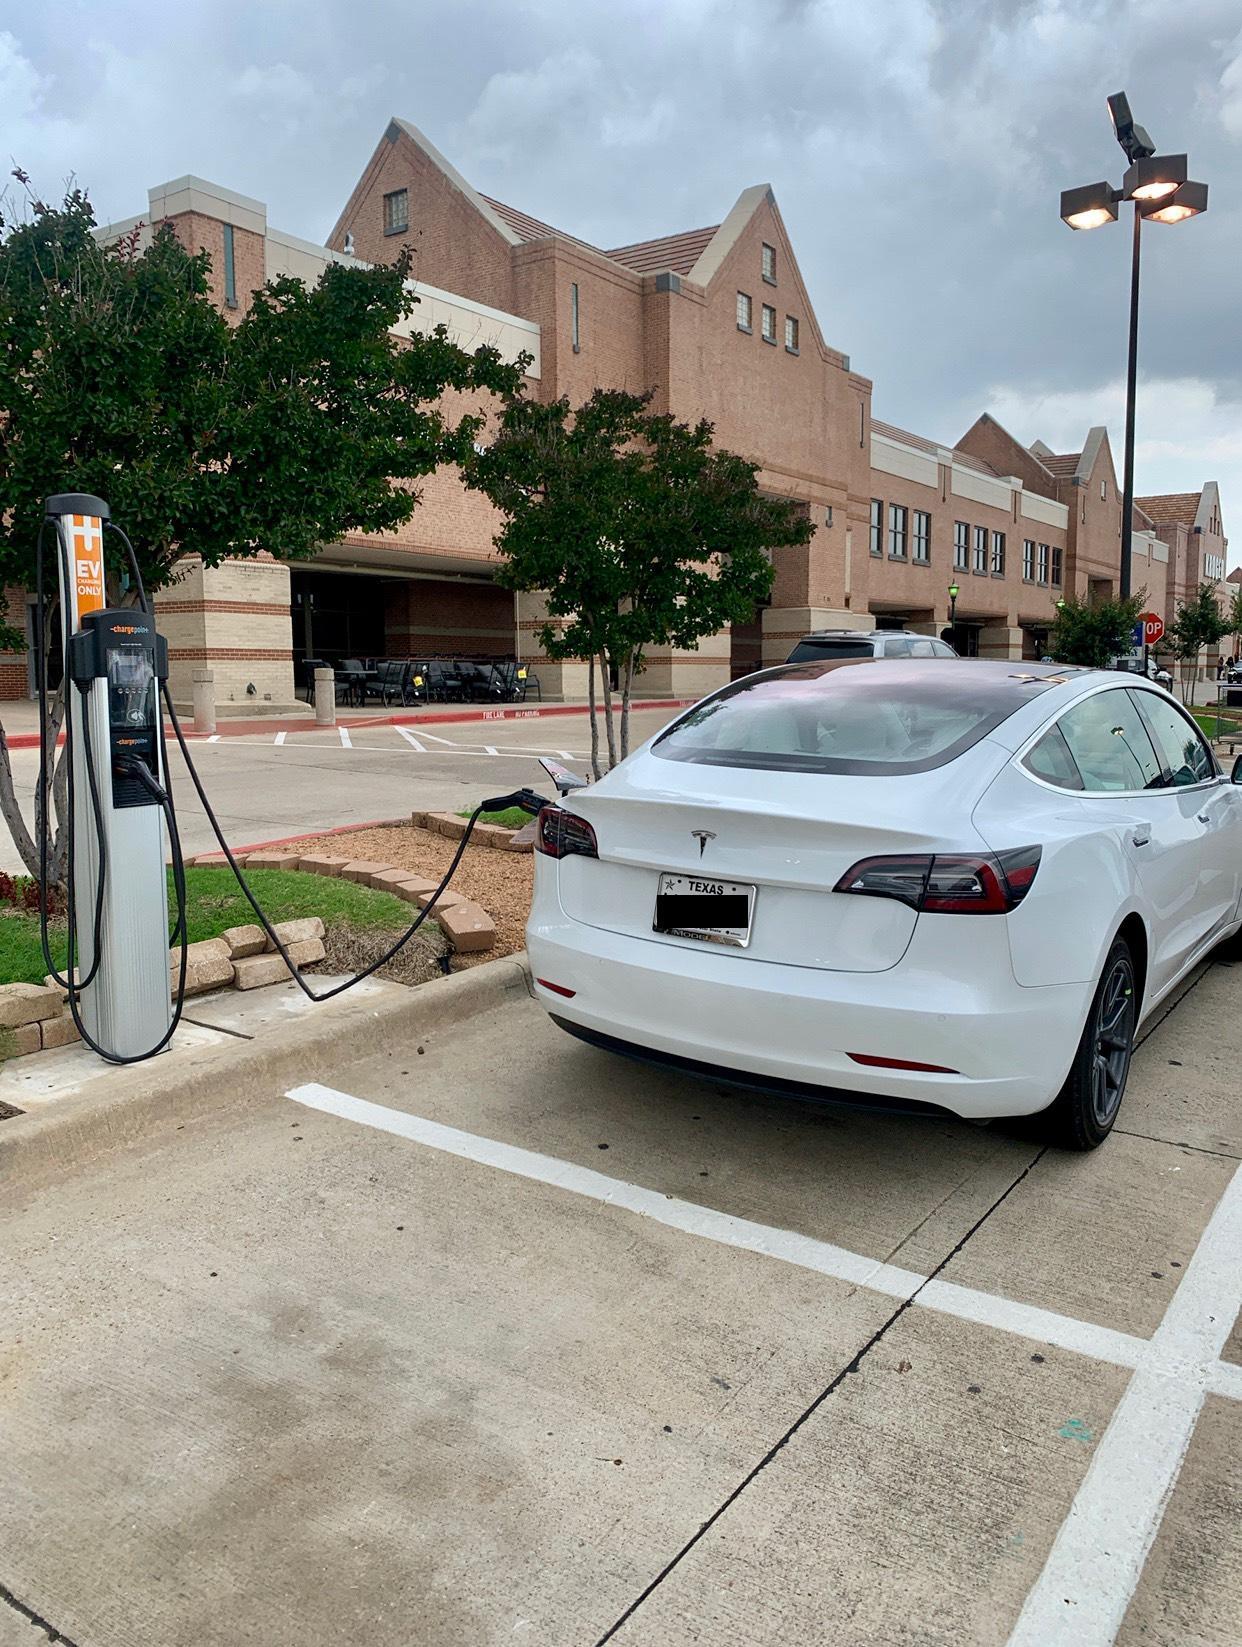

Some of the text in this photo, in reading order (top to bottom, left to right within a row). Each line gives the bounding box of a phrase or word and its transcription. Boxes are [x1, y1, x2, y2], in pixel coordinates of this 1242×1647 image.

[77, 560, 100, 578] EV
[78, 586, 101, 595] ONLY
[1147, 622, 1161, 635] OP
[689, 881, 724, 895] TEXAS
